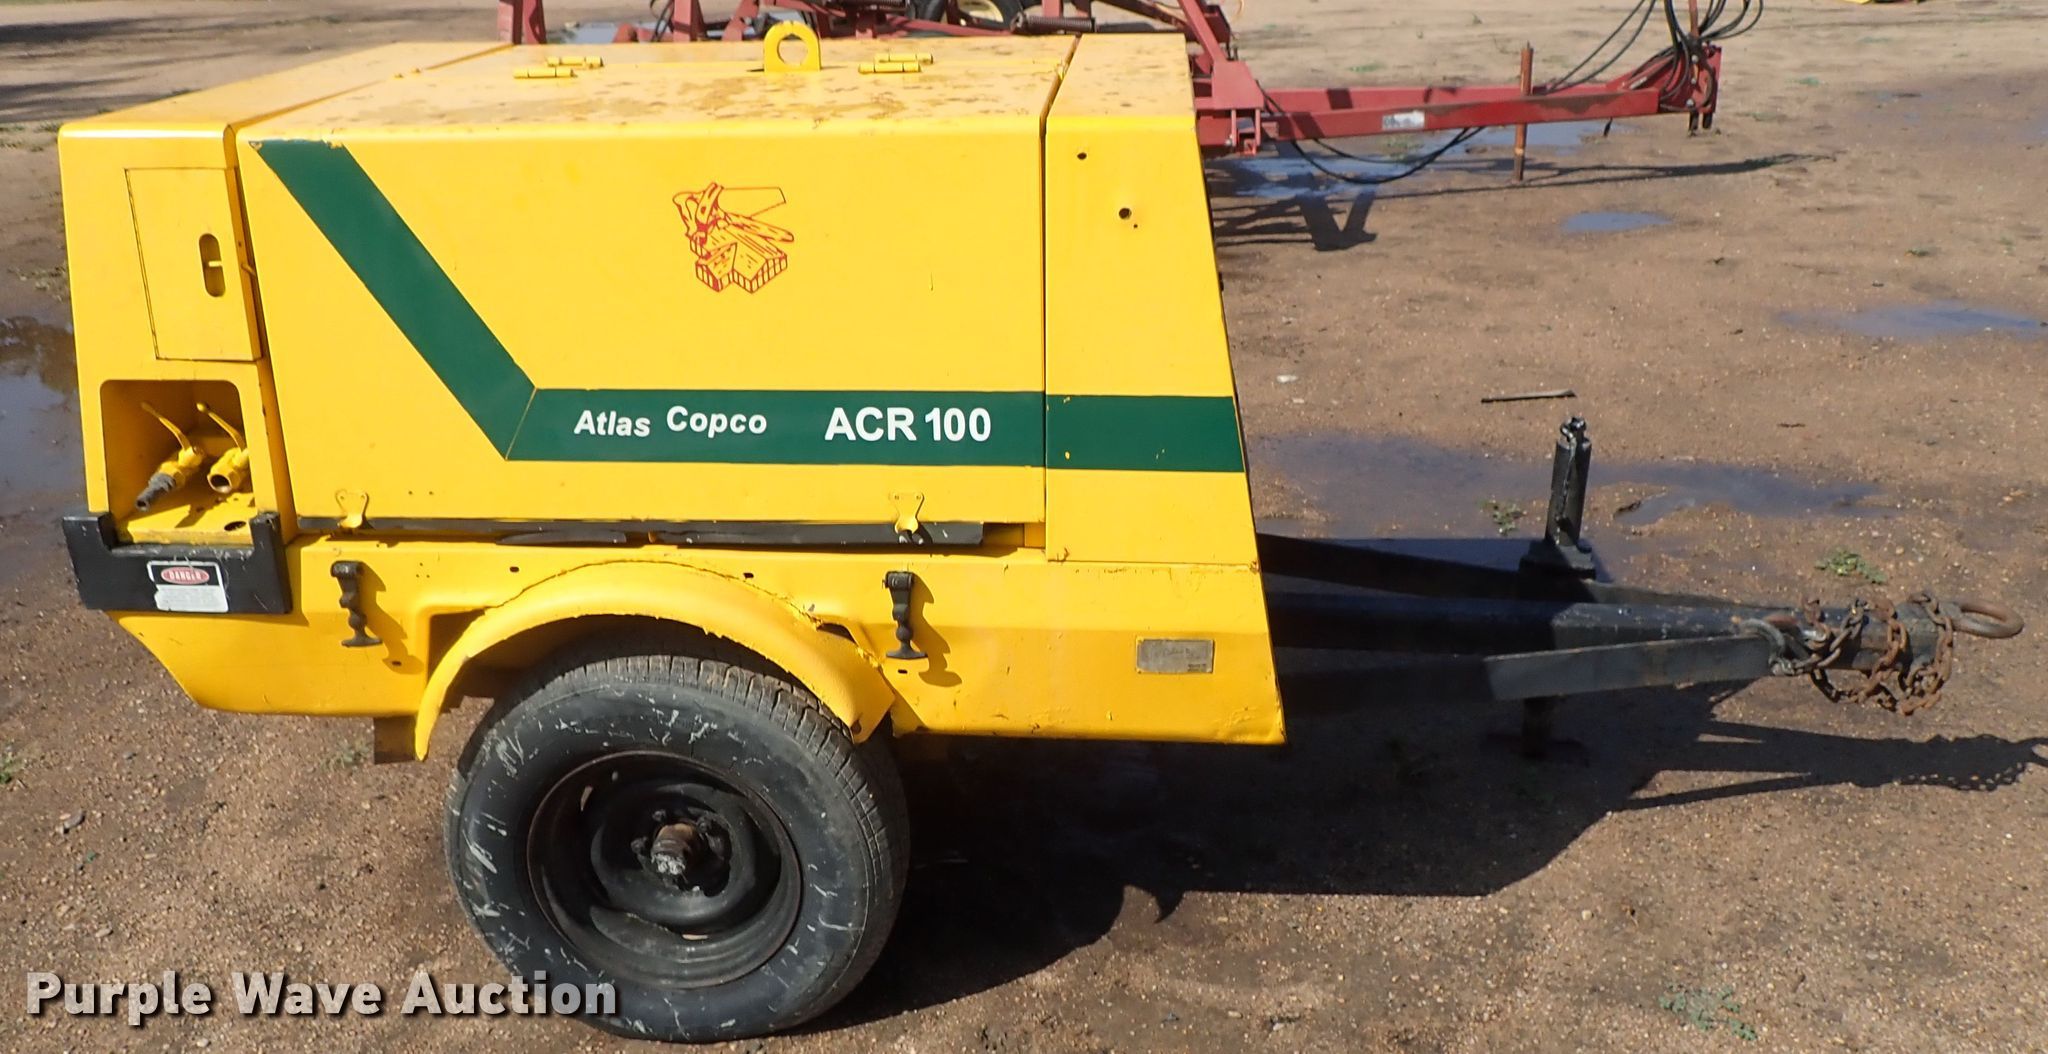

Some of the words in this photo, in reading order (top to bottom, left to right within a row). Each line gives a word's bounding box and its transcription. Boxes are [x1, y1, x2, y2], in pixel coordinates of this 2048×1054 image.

[574, 410, 651, 437] Atlas
[666, 406, 767, 439] Copco
[824, 407, 917, 441] ACR
[925, 407, 991, 442] 100
[168, 570, 202, 581] DANGER
